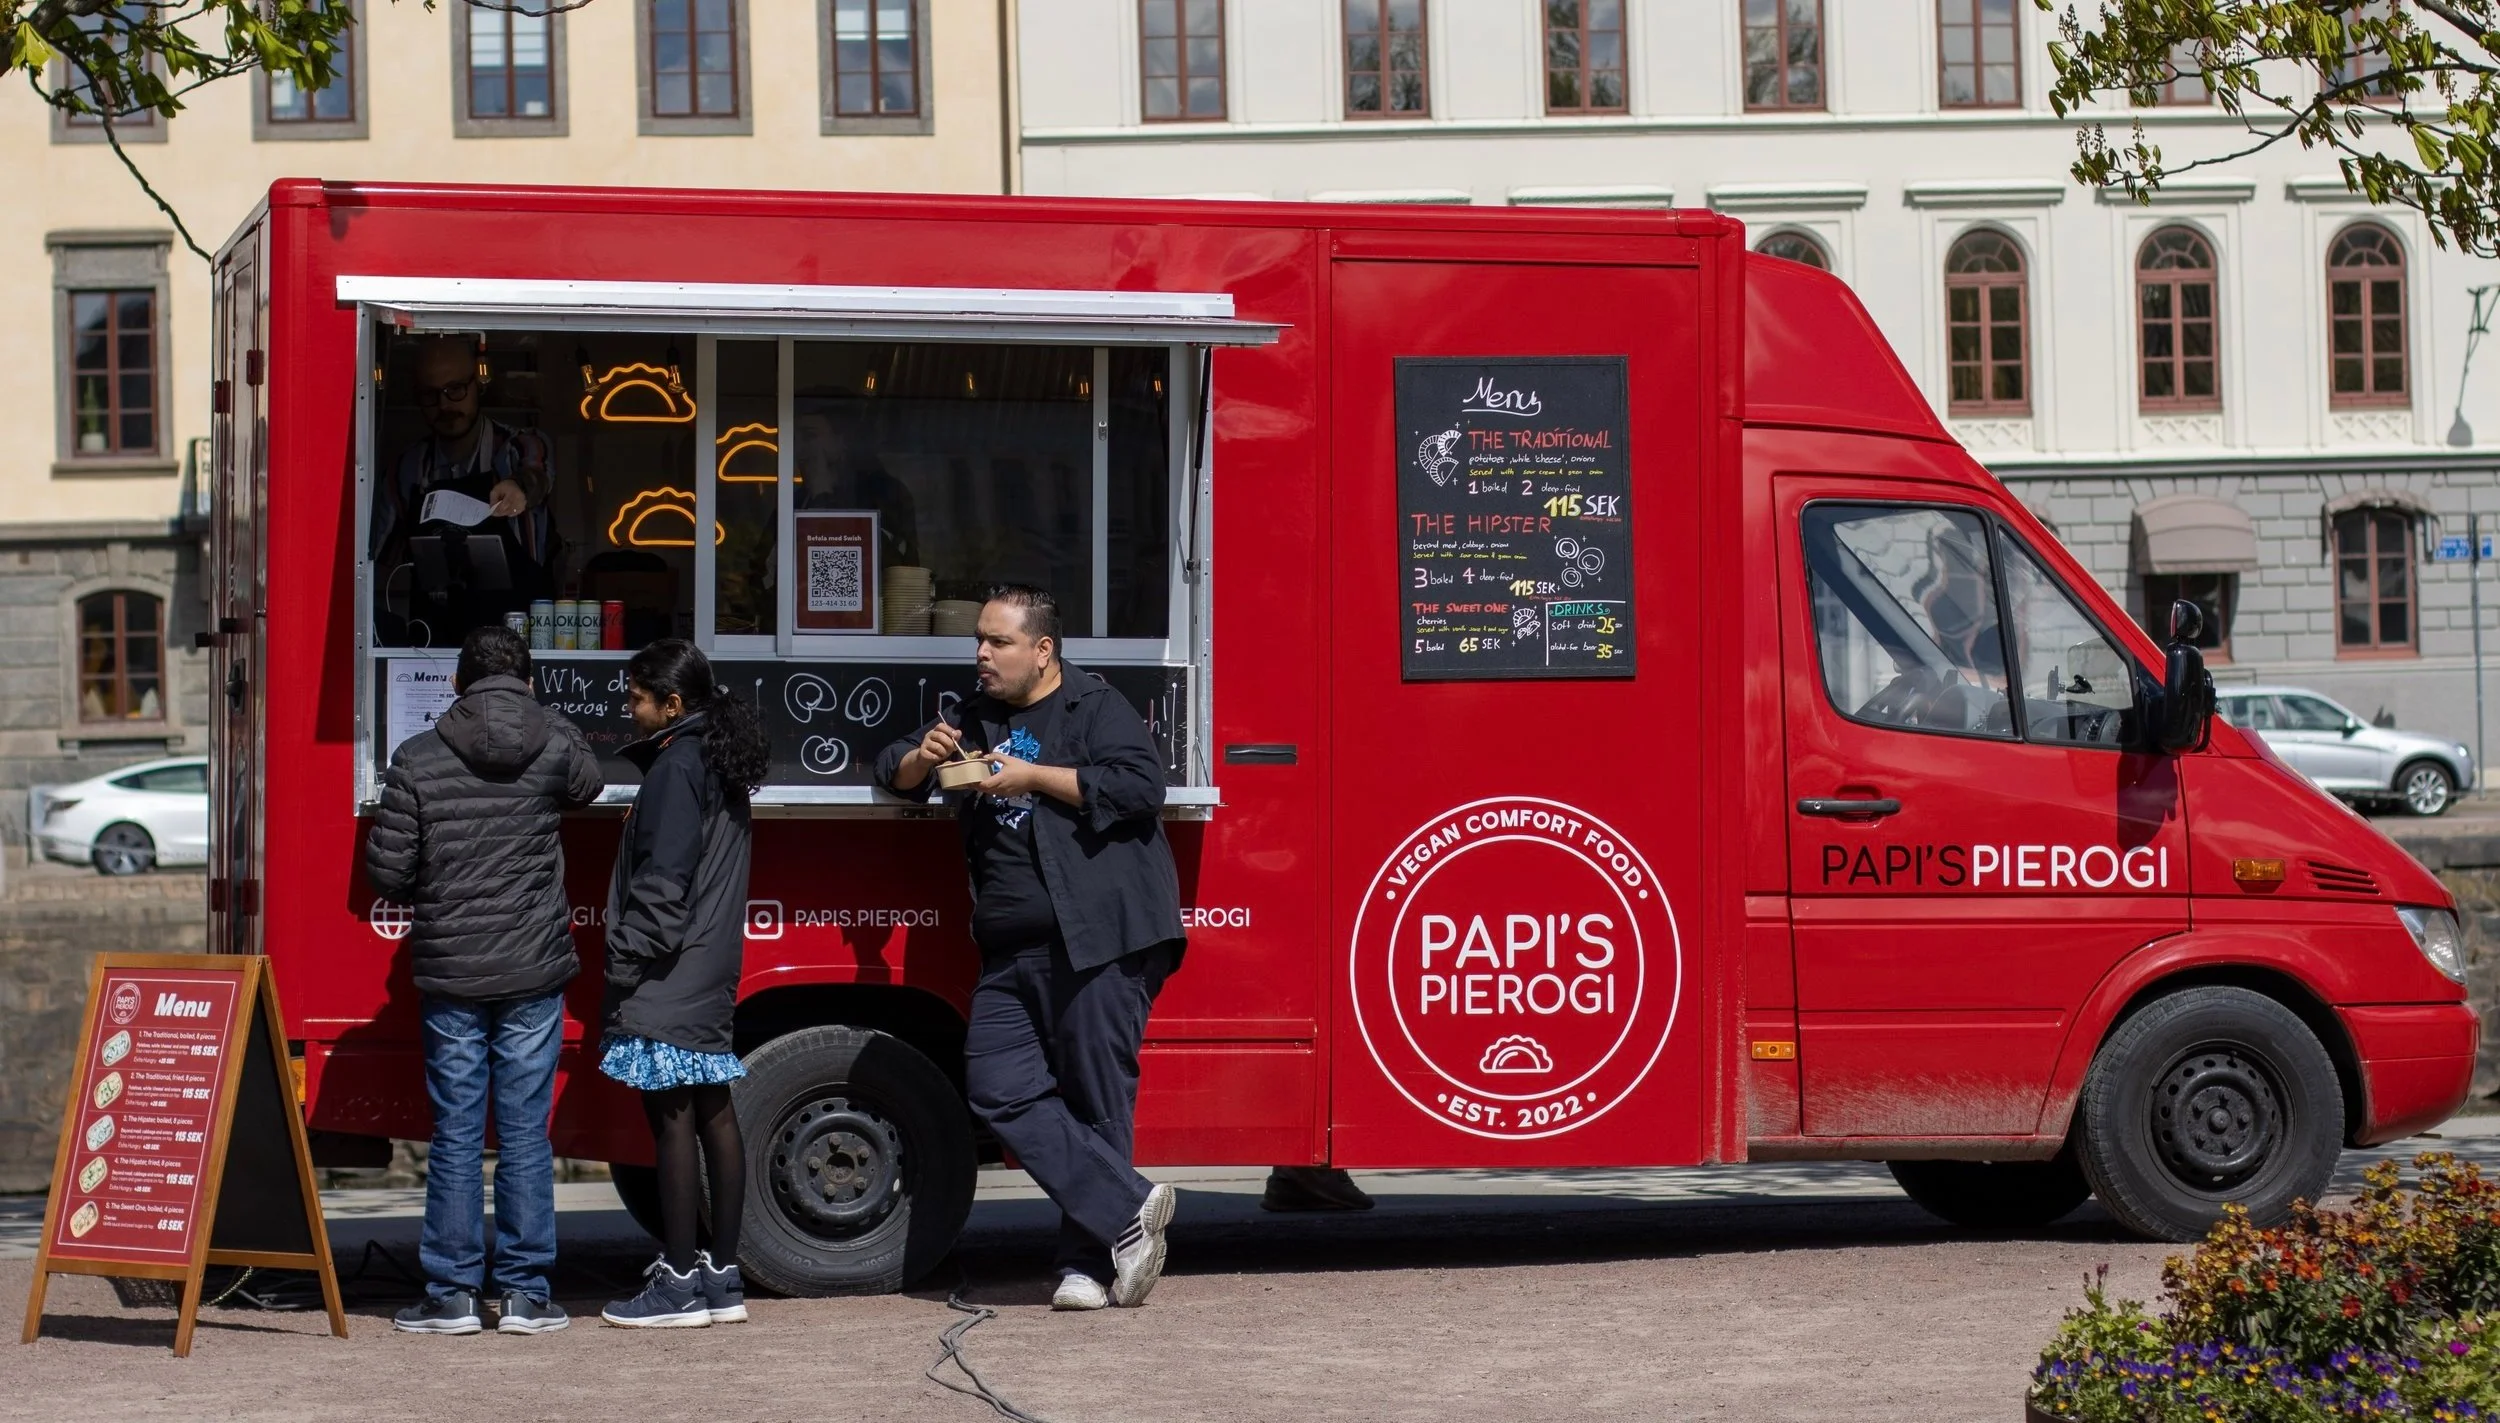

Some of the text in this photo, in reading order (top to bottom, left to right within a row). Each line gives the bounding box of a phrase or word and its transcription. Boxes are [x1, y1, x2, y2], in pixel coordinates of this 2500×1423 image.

[1463, 376, 1541, 413] Menu
[1468, 430, 1504, 450] THE
[1468, 480, 1478, 494] 1
[1522, 480, 1533, 495] 2
[1544, 494, 1620, 517] 115 SEK
[1412, 514, 1550, 536] THE HIPSTER
[1414, 568, 1428, 588] 3
[1462, 567, 1475, 584] 4
[1509, 580, 1556, 596] 115 SEK
[1412, 602, 1509, 615] THE SWEET ONE
[1554, 603, 1604, 616] DRINKS
[530, 616, 550, 627] OKA
[1417, 616, 1446, 626] cherries
[1552, 620, 1570, 630] soft
[1597, 616, 1616, 634] 25
[1415, 639, 1425, 653] 5
[1459, 638, 1478, 652] 65
[1482, 638, 1500, 649] SEK
[1596, 644, 1613, 658] 35
[414, 672, 447, 682] Menu
[541, 666, 593, 700] Why
[586, 728, 616, 744] make
[1387, 809, 1643, 888] VEGAN COMFORT FOOD
[795, 908, 940, 928] PAPIS.PIEROGI
[1180, 907, 1250, 928] EROGI
[1421, 914, 1614, 969] PAPI'S
[1420, 974, 1614, 1015] PIEROGI
[154, 993, 211, 1018] Menu
[152, 1032, 179, 1040] Traditional,
[191, 1045, 201, 1055] 115
[202, 1046, 219, 1056] SEK
[182, 1088, 194, 1098] 115
[194, 1089, 210, 1099] SEK
[1447, 1094, 1583, 1128] EST. 2022
[138, 1116, 156, 1124] Hipster,
[156, 1116, 172, 1124] boiled,
[175, 1131, 186, 1141] 115
[187, 1132, 203, 1142] SEK
[130, 1158, 147, 1166] Hipster,
[166, 1174, 178, 1184] 115
[178, 1174, 195, 1185] SEK
[168, 1206, 184, 1214] pieces
[158, 1220, 167, 1229] 65
[167, 1220, 184, 1231] SEK
